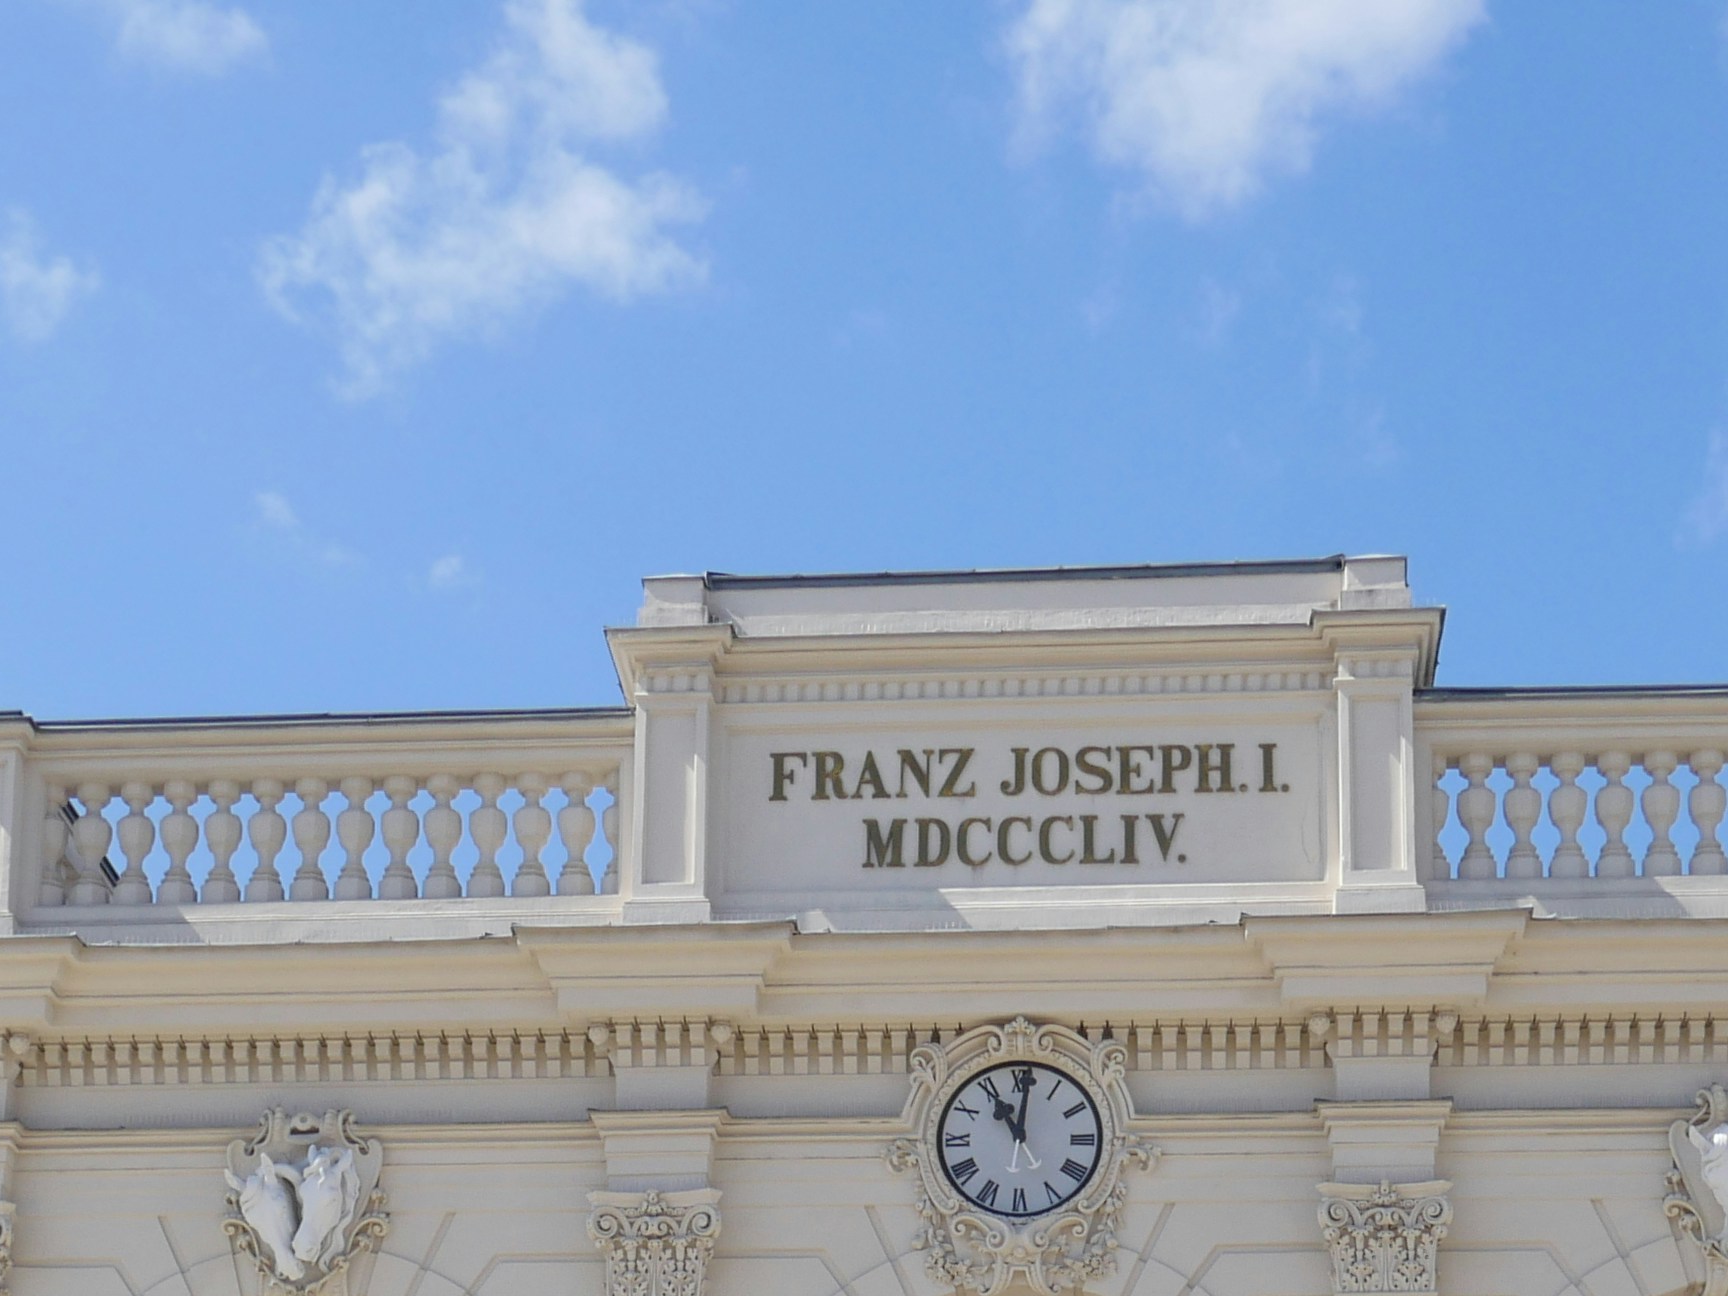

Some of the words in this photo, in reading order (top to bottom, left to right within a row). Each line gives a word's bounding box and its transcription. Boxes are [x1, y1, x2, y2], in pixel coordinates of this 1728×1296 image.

[768, 748, 976, 801] FRANZ
[861, 813, 1187, 868] MDCCCLIV.
[1063, 1101, 1087, 1120] II
[1070, 1133, 1095, 1146] III
